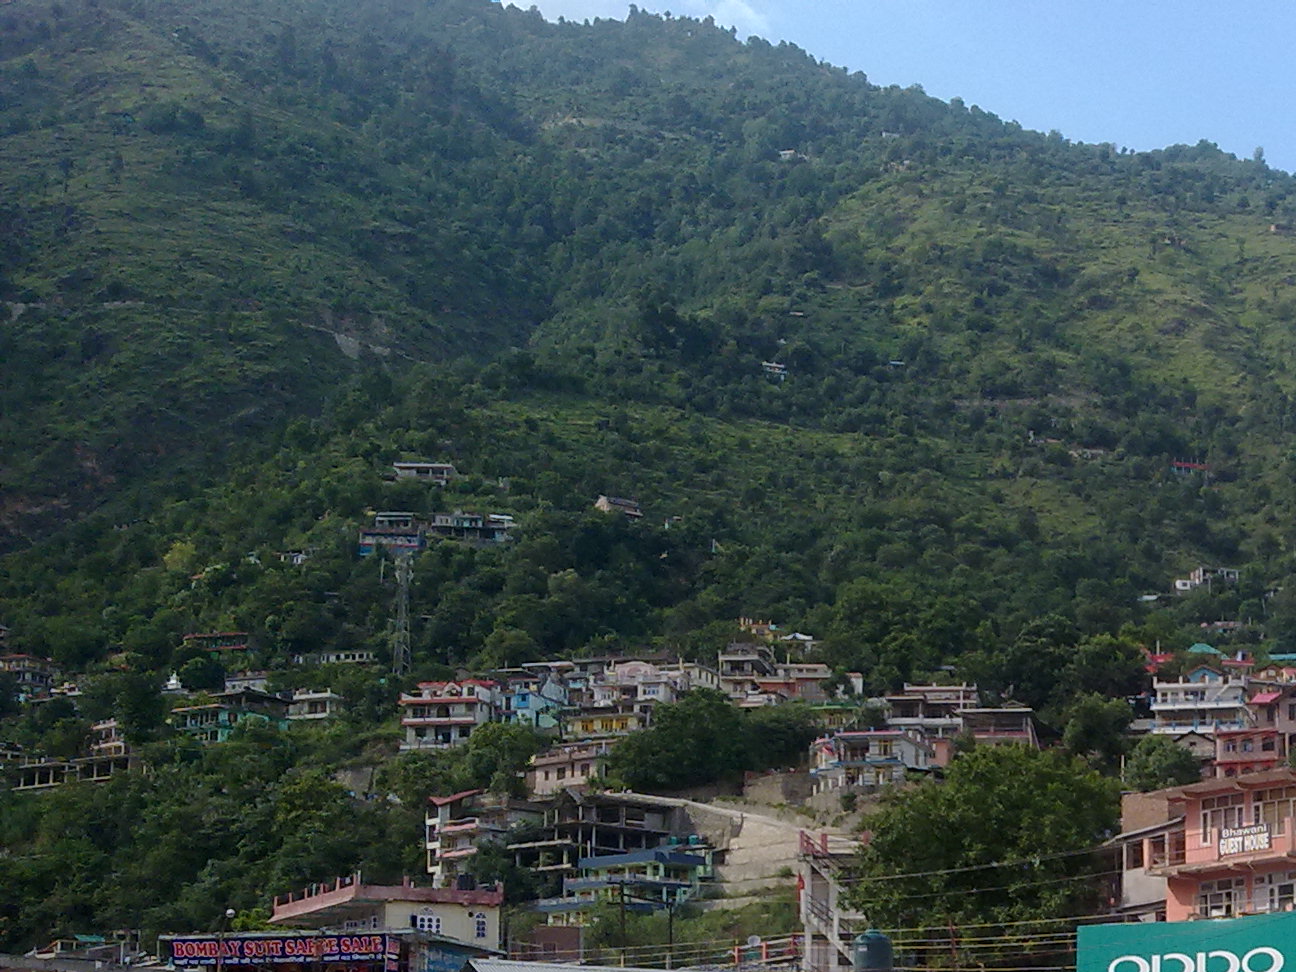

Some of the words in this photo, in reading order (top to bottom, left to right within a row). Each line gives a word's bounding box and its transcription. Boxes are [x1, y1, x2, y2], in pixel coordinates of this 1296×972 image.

[1222, 825, 1267, 838] Bhawani
[1220, 837, 1243, 855] GUEST
[1244, 833, 1269, 851] HOUSE
[172, 940, 242, 958] BOMBAY
[243, 939, 283, 956] SUIT
[340, 936, 384, 954] SALE
